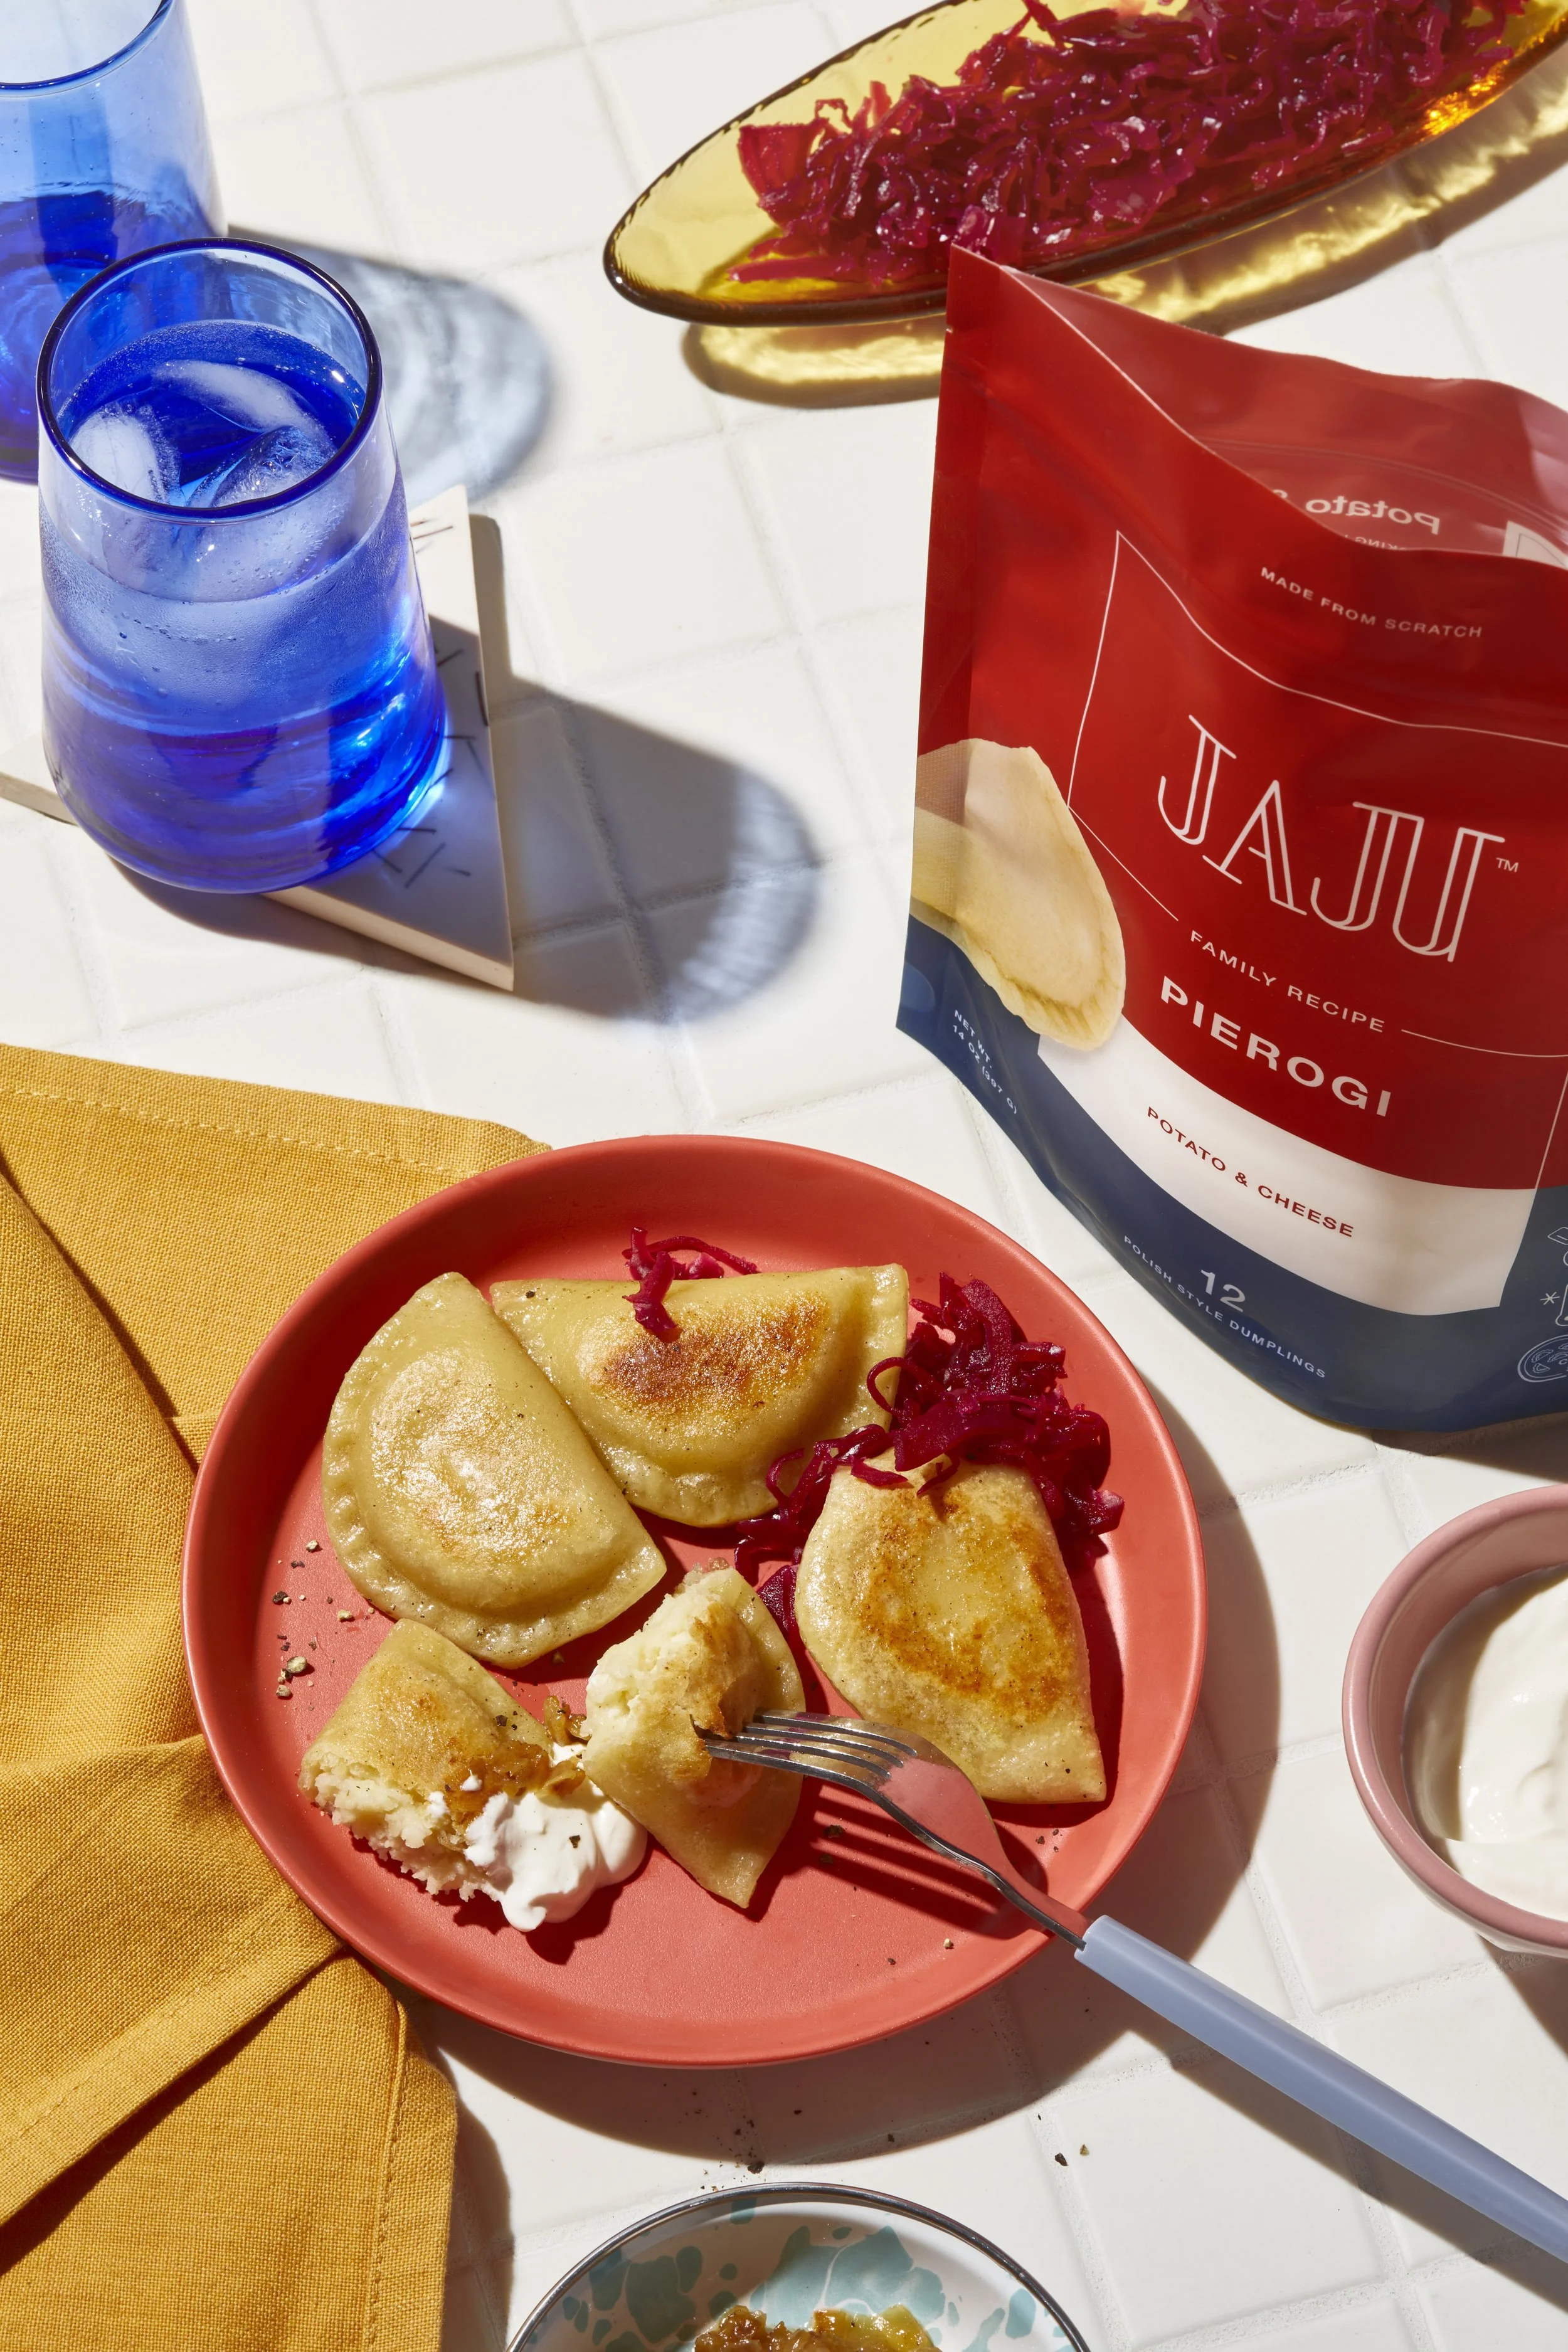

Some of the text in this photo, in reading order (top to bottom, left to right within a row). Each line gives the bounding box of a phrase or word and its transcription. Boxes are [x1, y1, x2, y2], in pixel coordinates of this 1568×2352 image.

[1261, 567, 1483, 638] MADE FROM SCRATCH
[1158, 714, 1505, 962] JAJU
[1190, 930, 1385, 1032] FAMILY RECIPE
[953, 1025, 1017, 1114] 14 OZ (397 G)
[954, 1009, 993, 1069] NET WT.
[1160, 975, 1392, 1117] PIEROGI
[1147, 1106, 1354, 1238] POTATO & CHEESE
[1124, 1235, 1326, 1379] POLISH STYLE DUMPLINGS
[1200, 1269, 1246, 1313] 12
